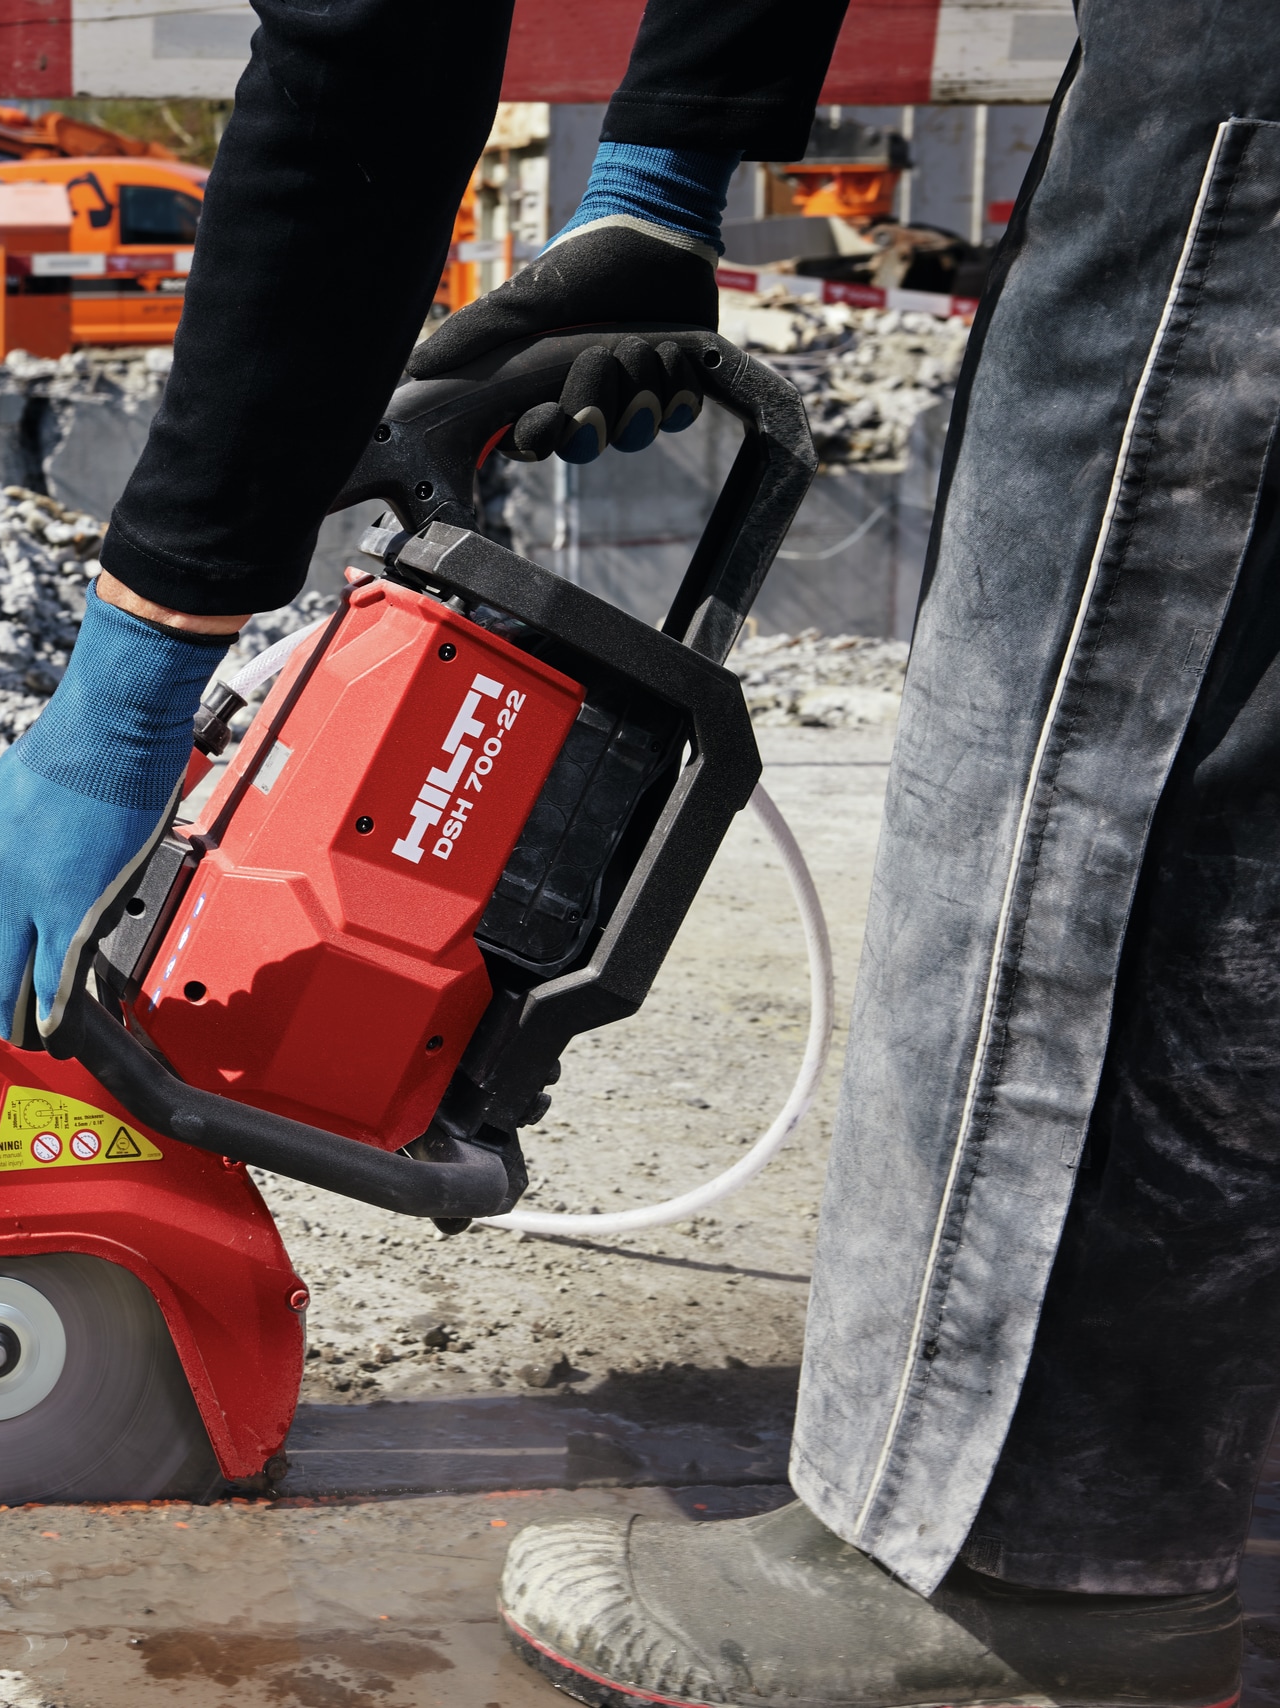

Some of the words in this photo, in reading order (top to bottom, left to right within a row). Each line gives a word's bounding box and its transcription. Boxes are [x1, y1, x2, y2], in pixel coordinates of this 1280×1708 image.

[391, 673, 504, 864] HILTI
[431, 797, 474, 860] DSH
[464, 689, 527, 793] 700-22
[8, 1159, 24, 1167] injury!
